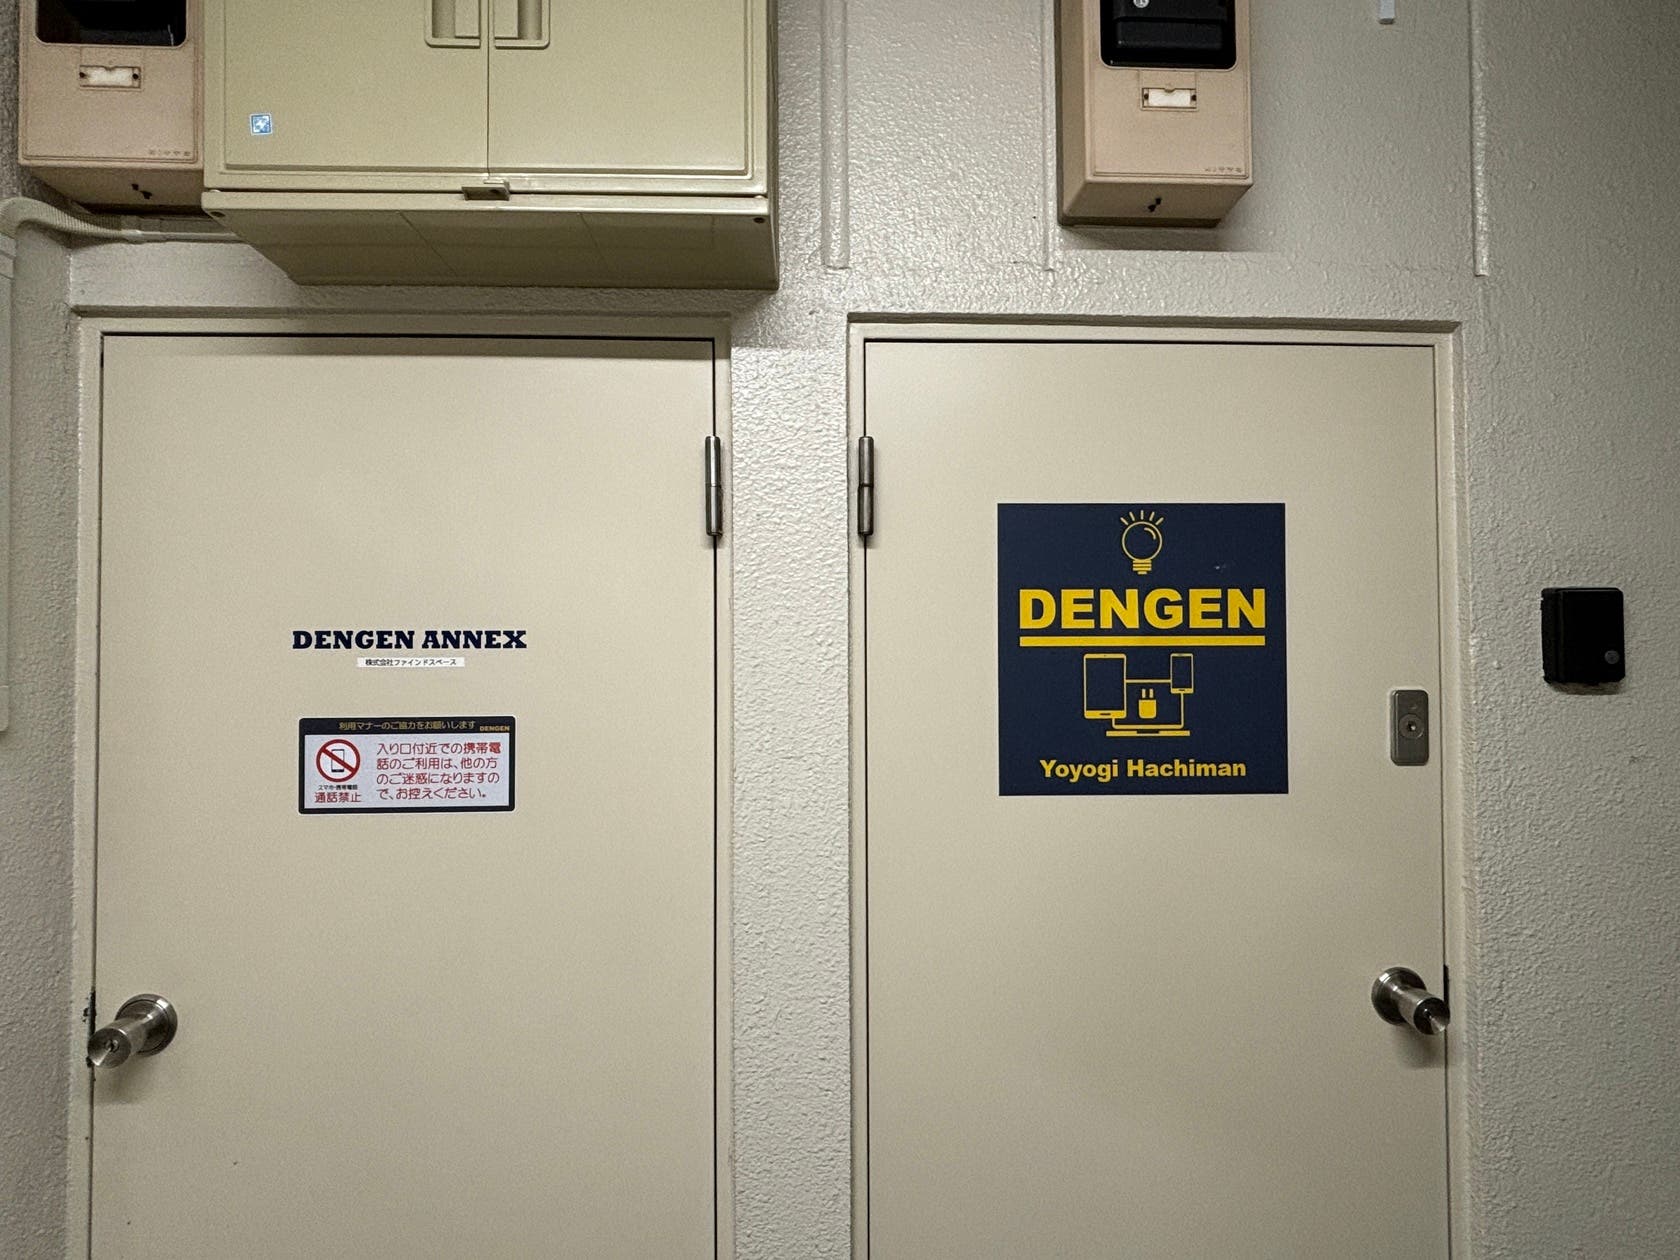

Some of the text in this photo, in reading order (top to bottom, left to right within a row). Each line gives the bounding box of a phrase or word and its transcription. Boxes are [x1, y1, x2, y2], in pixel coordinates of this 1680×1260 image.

[1019, 588, 1267, 629] DENGEN
[292, 630, 527, 649] DENGEN ANNEX
[377, 742, 502, 755] 入り口付近での携帯電
[377, 757, 498, 770] 話のご利用は、他の方
[1040, 759, 1247, 782] Yoyogi Hachiman
[376, 772, 500, 785] のご迷惑になりますの
[314, 792, 361, 803] 通話禁止
[378, 787, 487, 800] で、お控えください。
